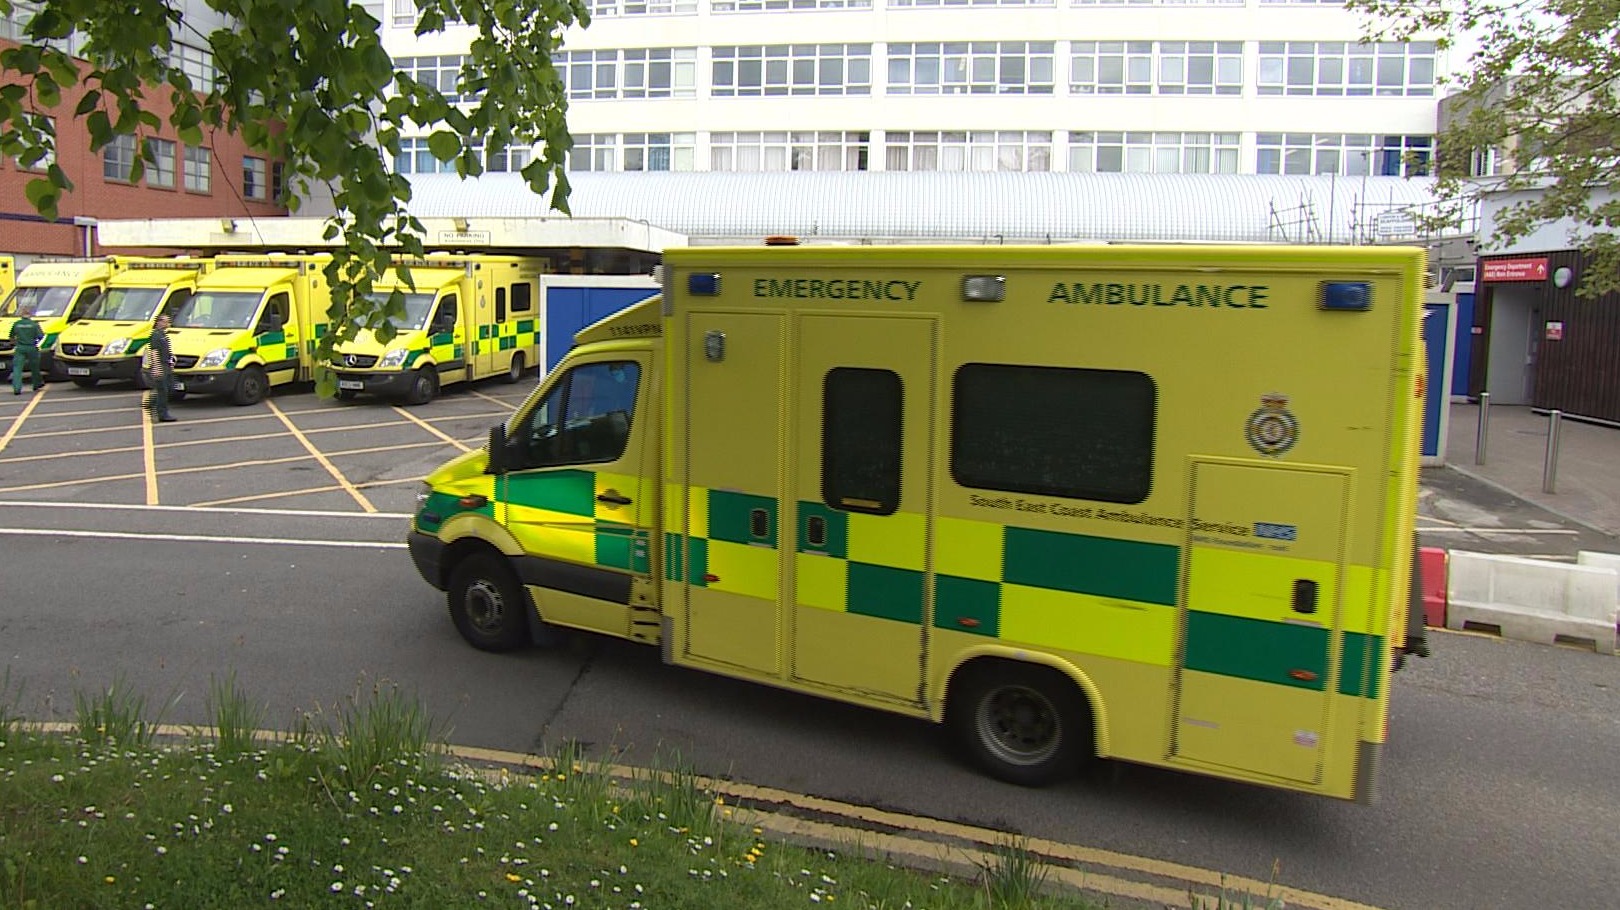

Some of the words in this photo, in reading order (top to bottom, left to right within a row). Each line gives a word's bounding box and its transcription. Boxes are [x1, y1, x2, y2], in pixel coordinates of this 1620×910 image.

[753, 278, 922, 300] EMERGENCY
[1047, 282, 1269, 308] AMBULANCE
[969, 494, 1013, 510] South
[1015, 499, 1047, 514] East
[1051, 503, 1093, 518] Coast
[1096, 508, 1185, 529] Ambulance
[1189, 517, 1251, 537] Service
[1256, 523, 1296, 540] NHS
